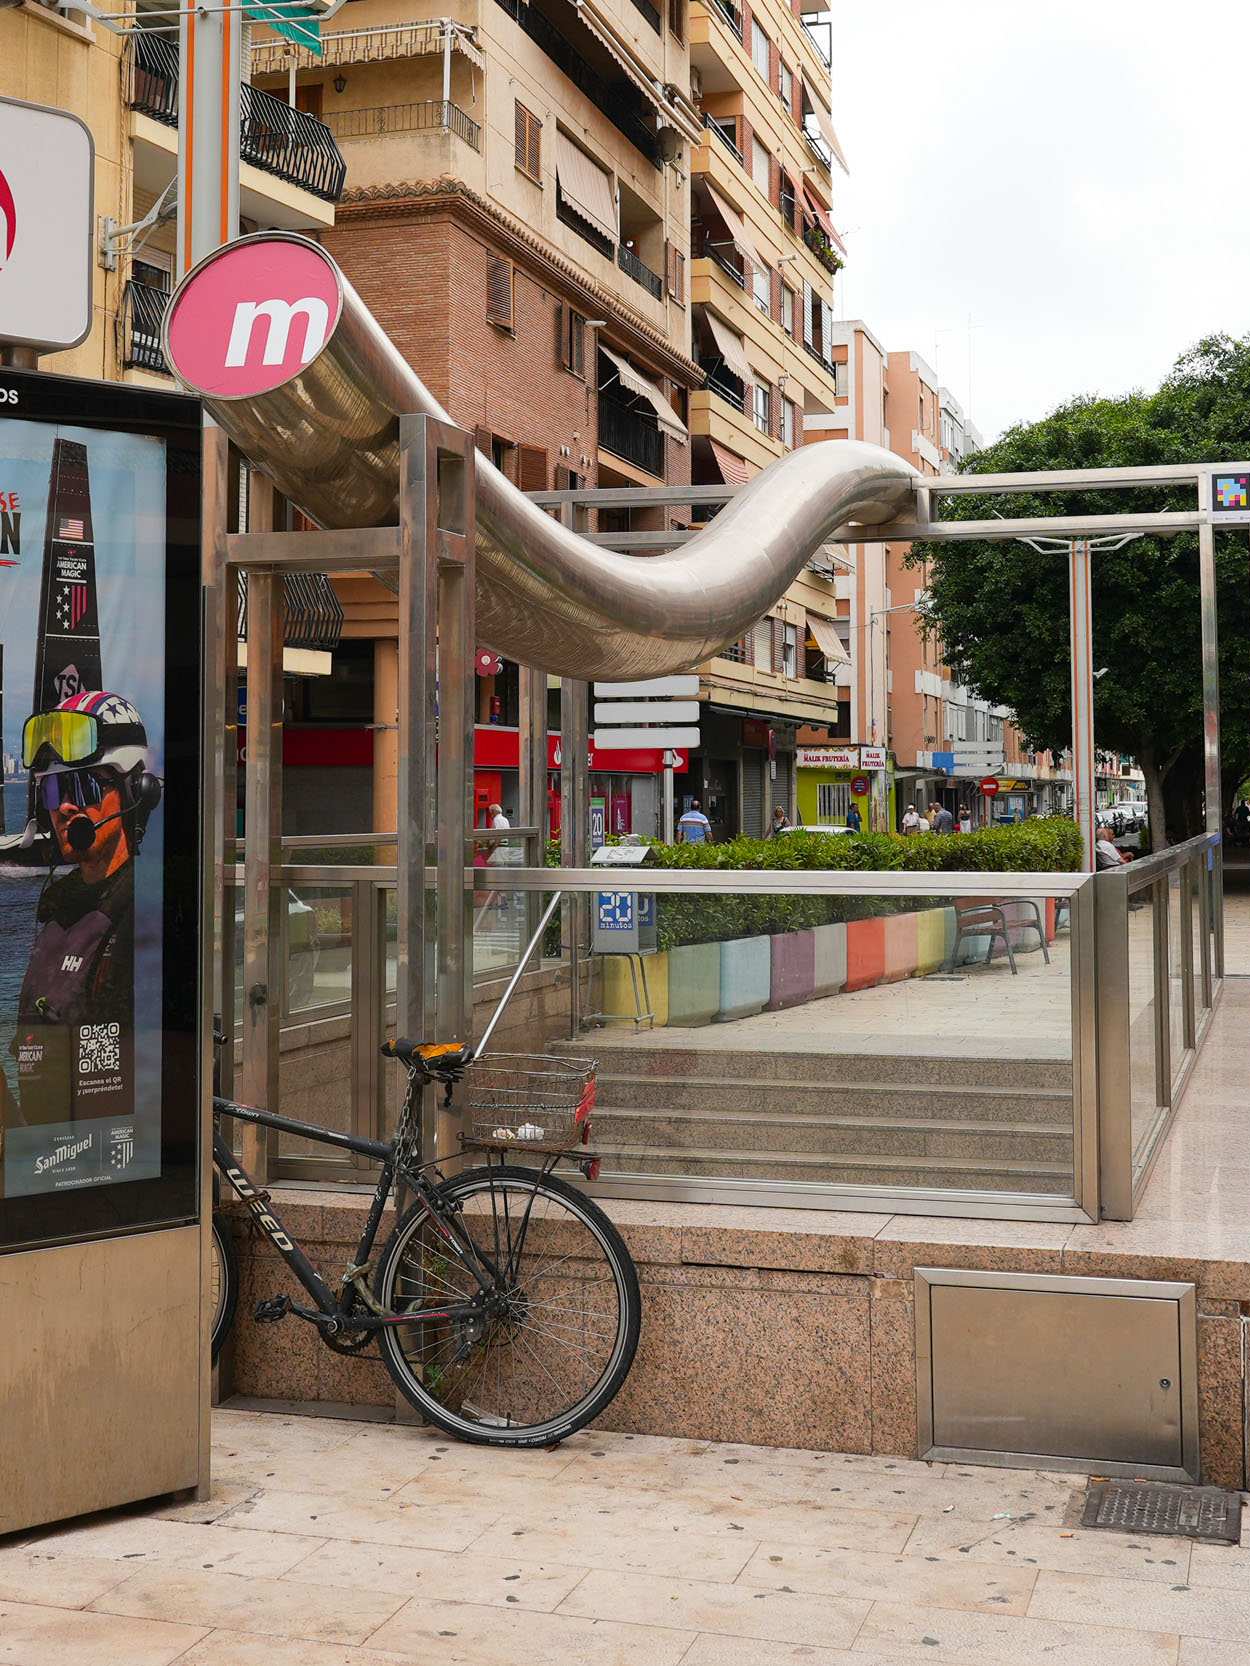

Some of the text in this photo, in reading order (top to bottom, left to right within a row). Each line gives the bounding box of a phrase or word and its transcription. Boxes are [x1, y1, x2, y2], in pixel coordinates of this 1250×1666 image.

[225, 297, 329, 368] m
[57, 560, 87, 570] AMERICAN
[61, 568, 81, 577] MAGIC
[803, 754, 850, 762] MALIK FRUTERÍA
[593, 812, 603, 836] 20
[600, 892, 632, 922] 20
[61, 955, 83, 972] HH
[113, 1076, 122, 1084] QR
[77, 1089, 82, 1097] y
[110, 1128, 133, 1136] AMERICAN
[55, 1175, 112, 1187] PATROCINADOR OFICIAL
